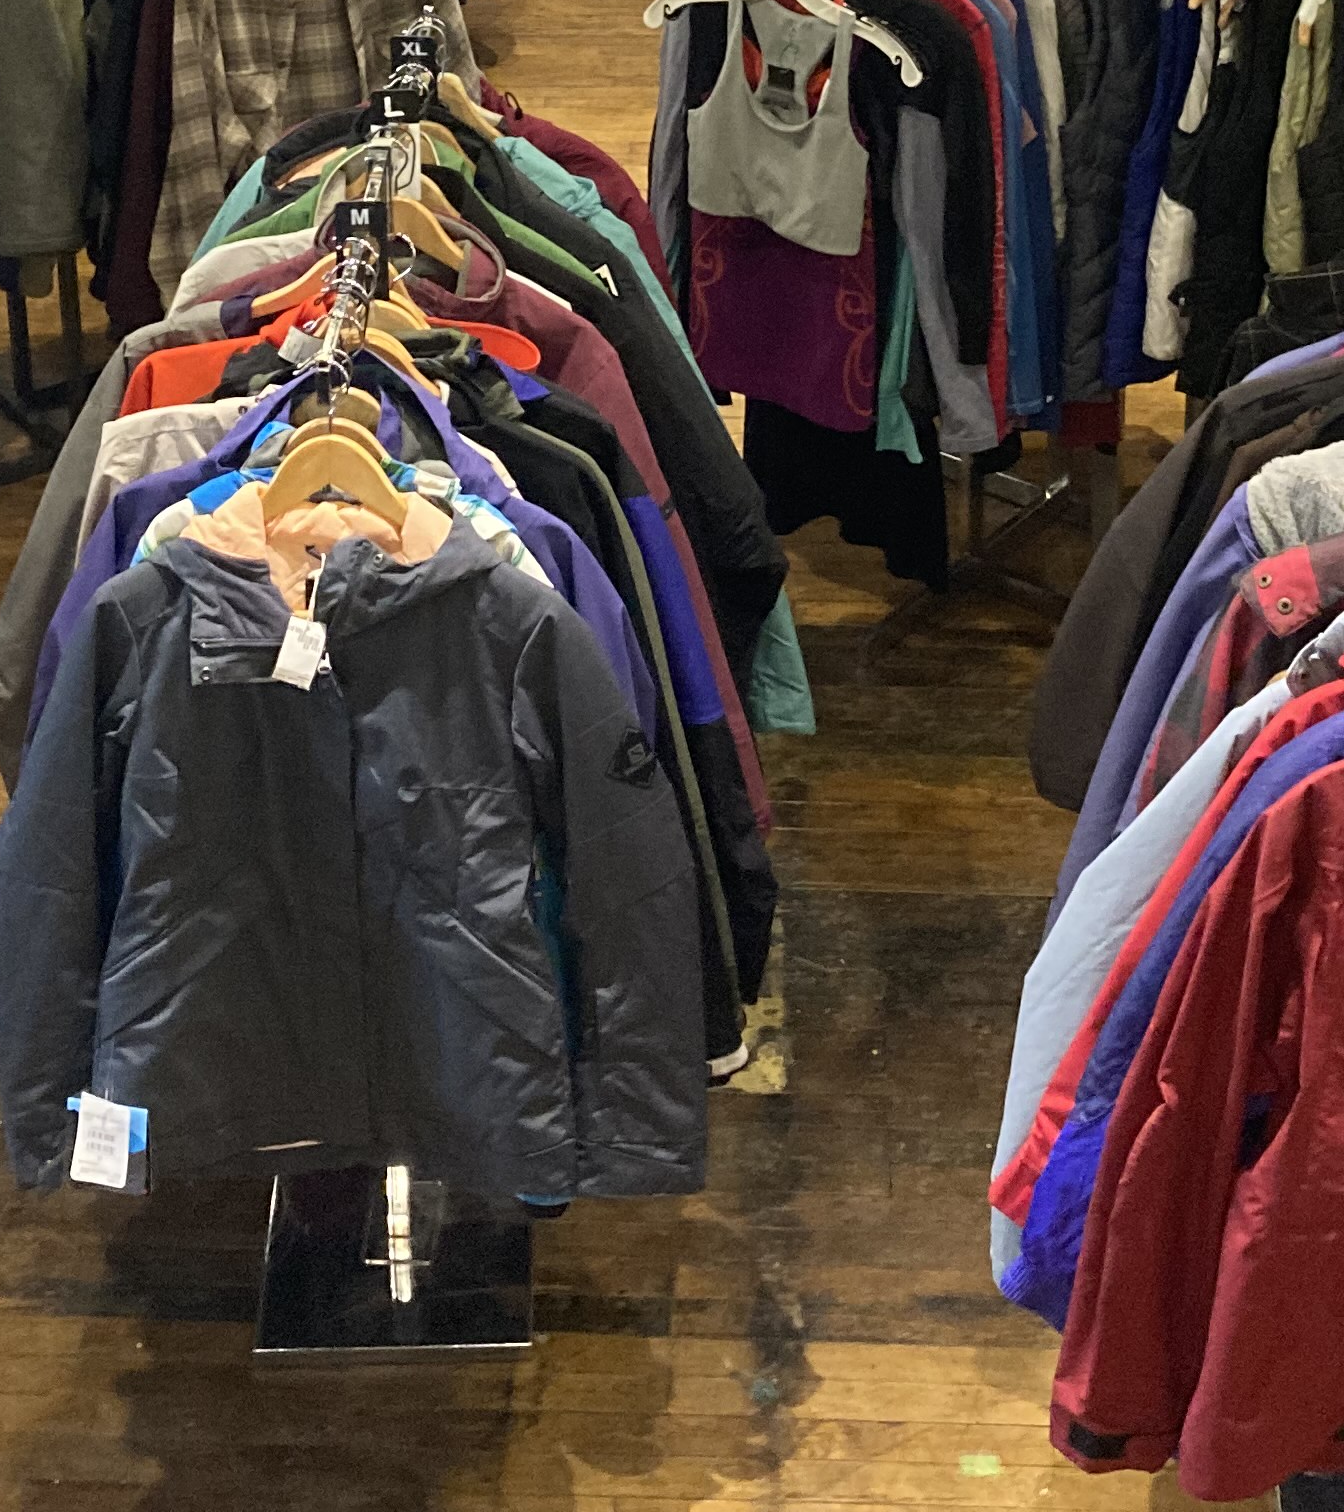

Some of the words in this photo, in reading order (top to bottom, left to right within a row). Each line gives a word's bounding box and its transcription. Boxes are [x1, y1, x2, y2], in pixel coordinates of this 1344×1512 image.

[401, 41, 428, 56] XL
[383, 96, 405, 118] L
[350, 208, 370, 226] M
